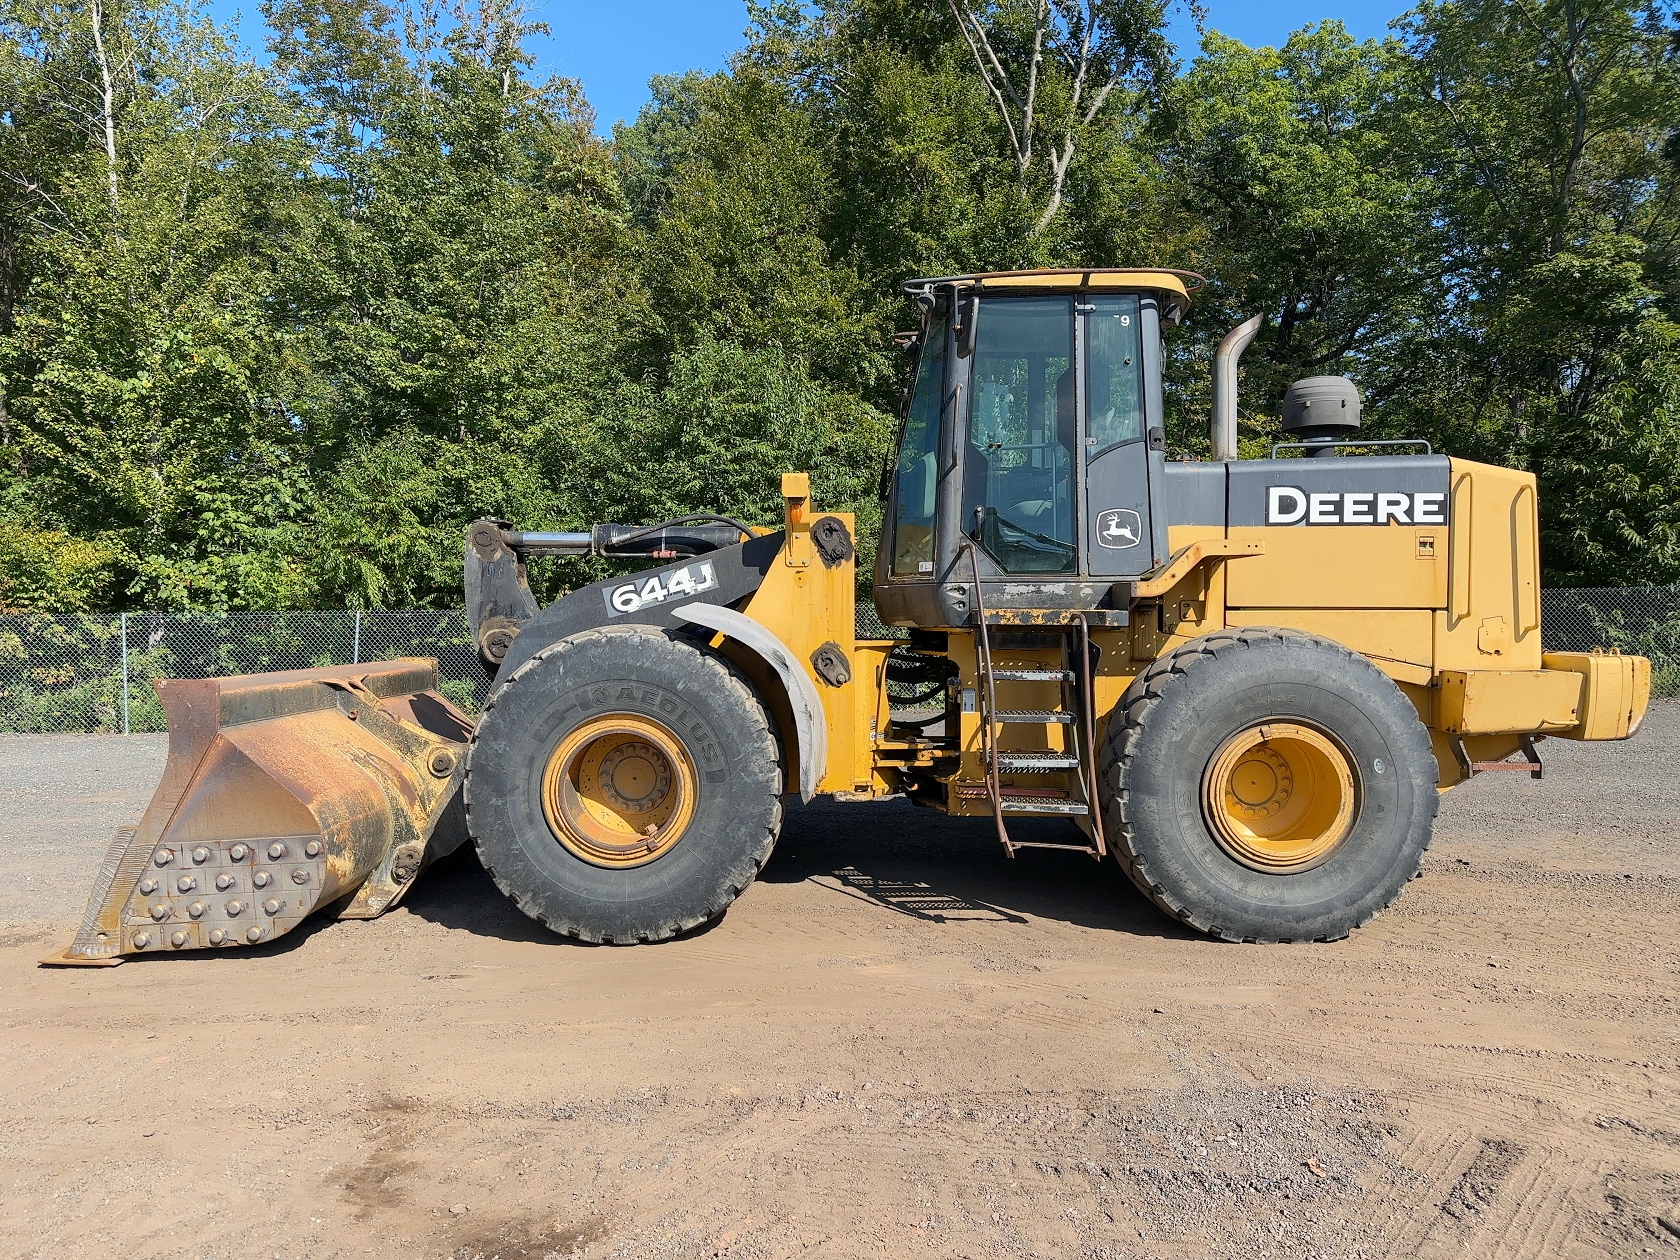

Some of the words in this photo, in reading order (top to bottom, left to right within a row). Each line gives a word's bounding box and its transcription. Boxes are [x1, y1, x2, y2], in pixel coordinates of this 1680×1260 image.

[1268, 486, 1445, 524] DEERE
[611, 563, 714, 614] 644J
[616, 688, 718, 765] AEOLUS
